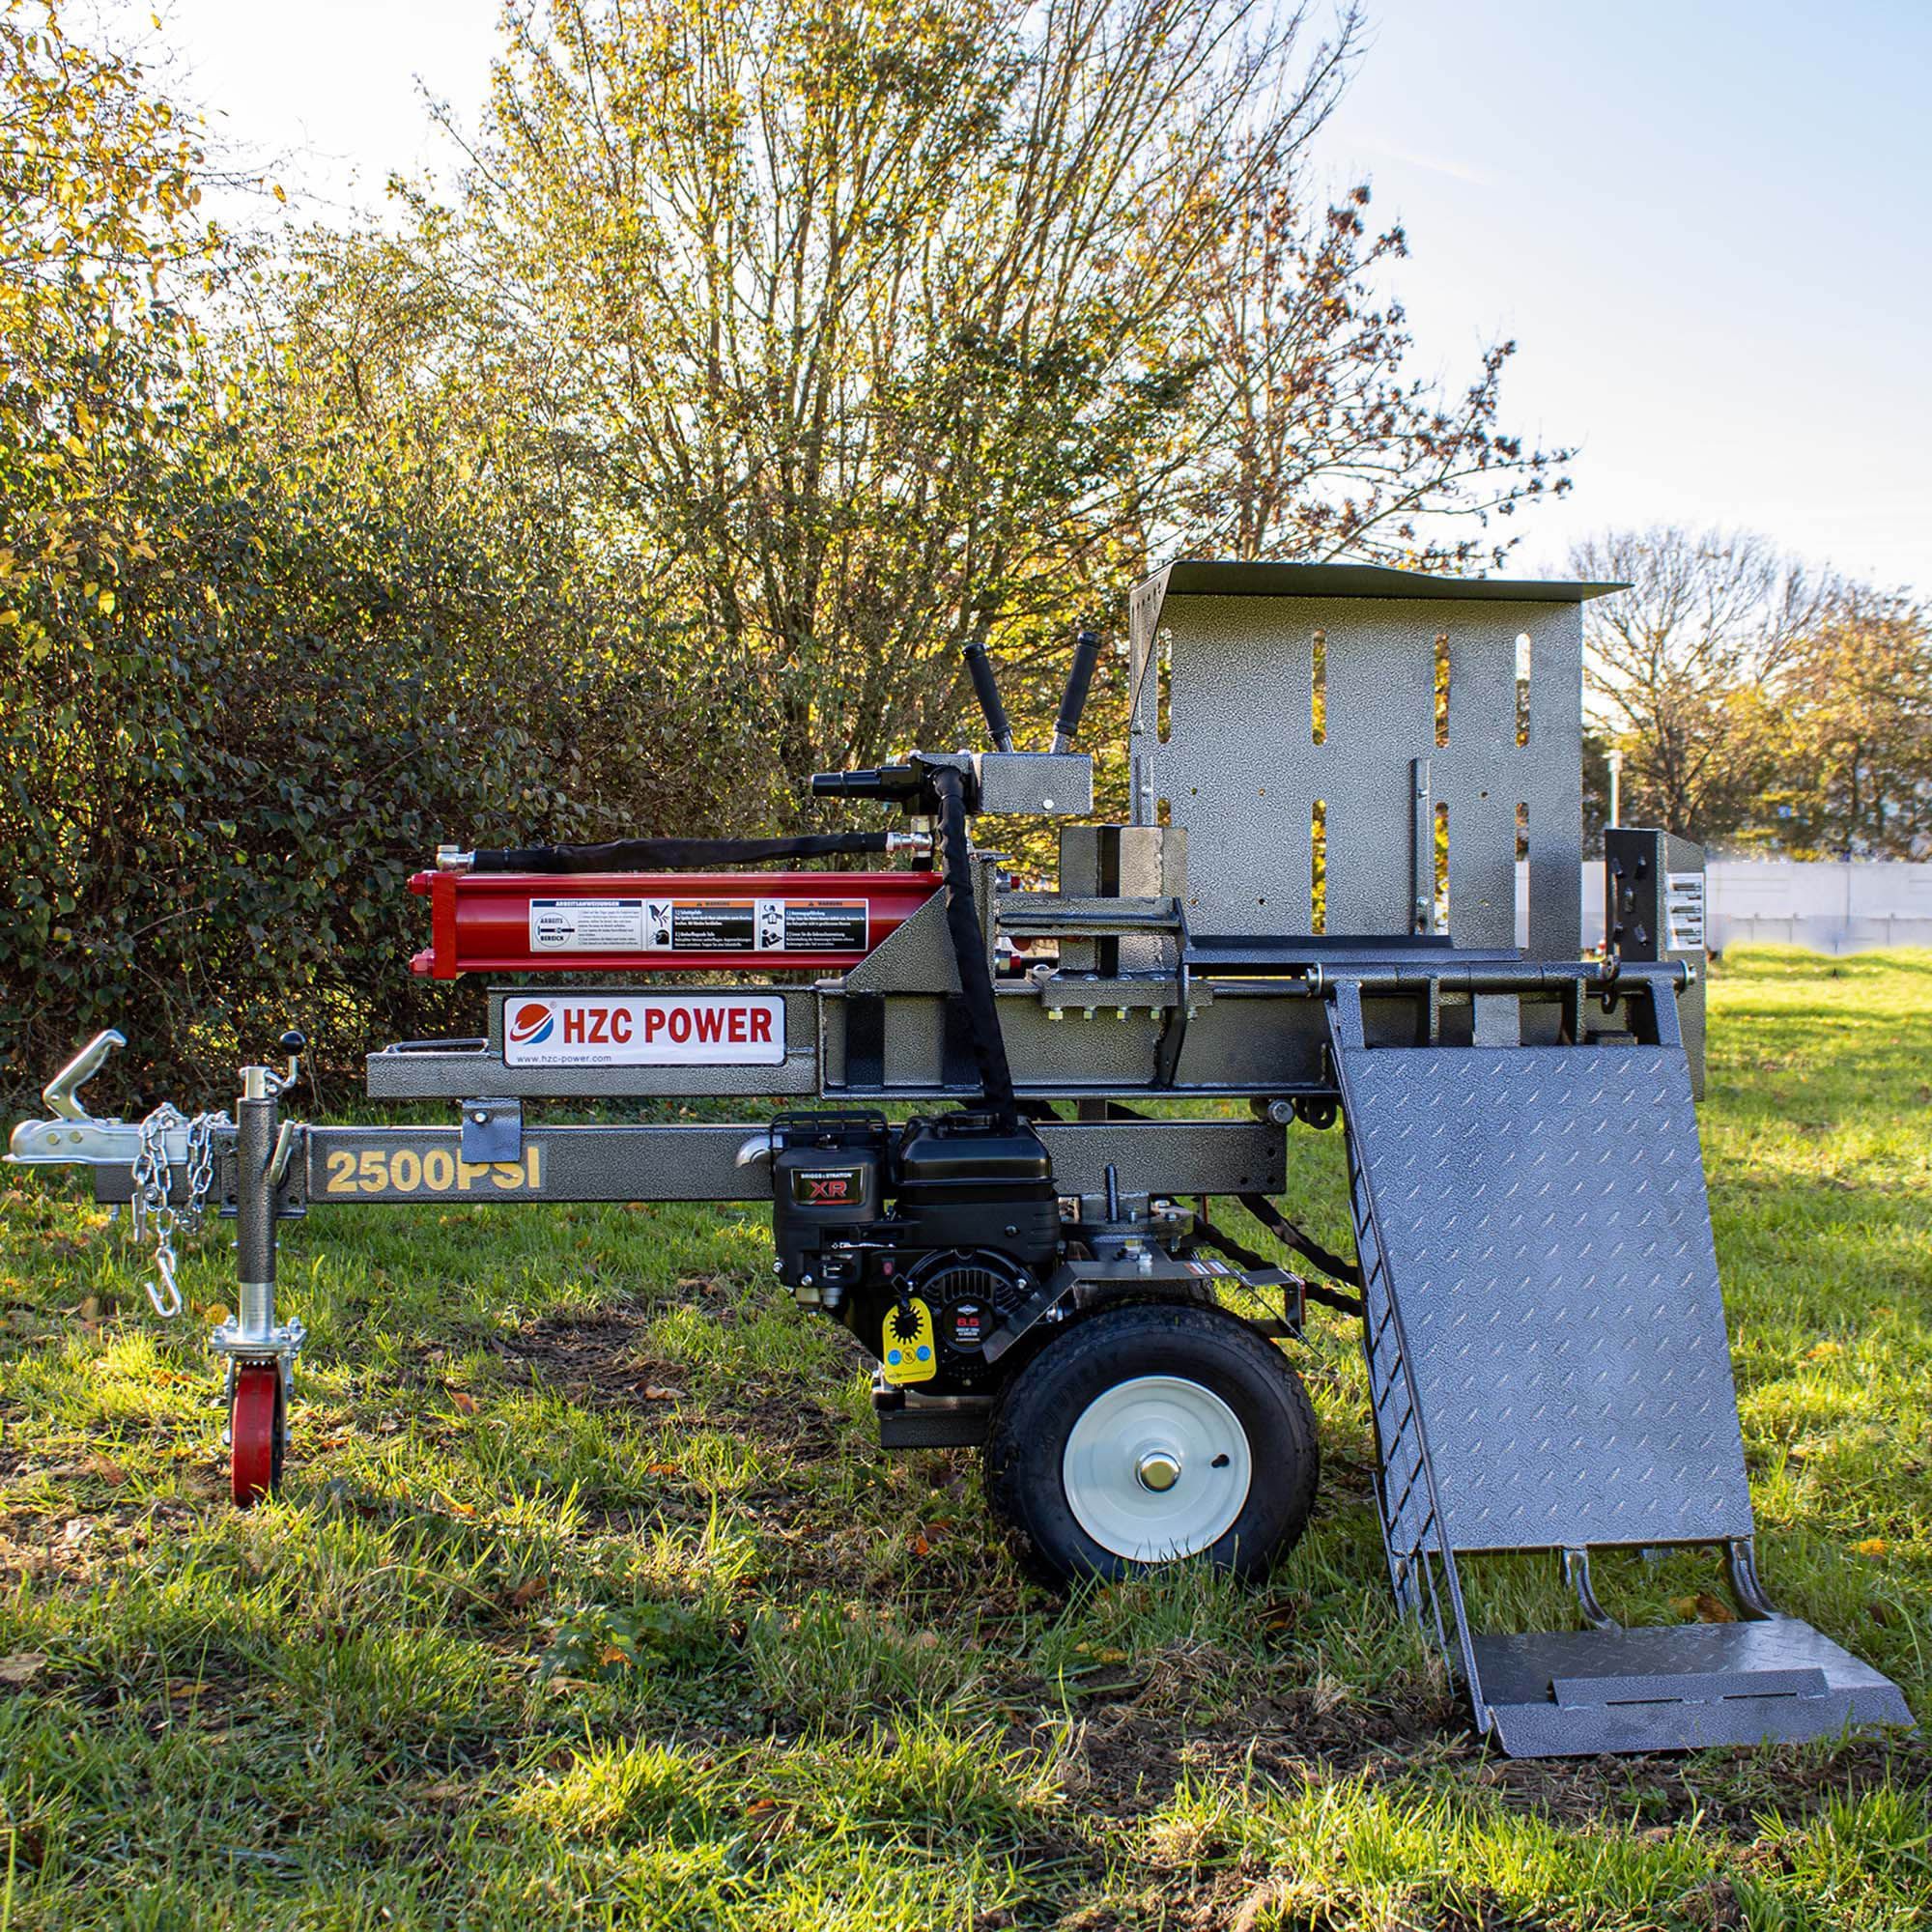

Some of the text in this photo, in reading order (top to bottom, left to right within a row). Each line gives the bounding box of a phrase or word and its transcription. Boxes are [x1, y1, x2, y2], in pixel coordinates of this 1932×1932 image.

[563, 1008, 773, 1044] HZC POWER
[517, 1054, 611, 1064] www.hzc-power.com
[810, 1180, 847, 1198] XR
